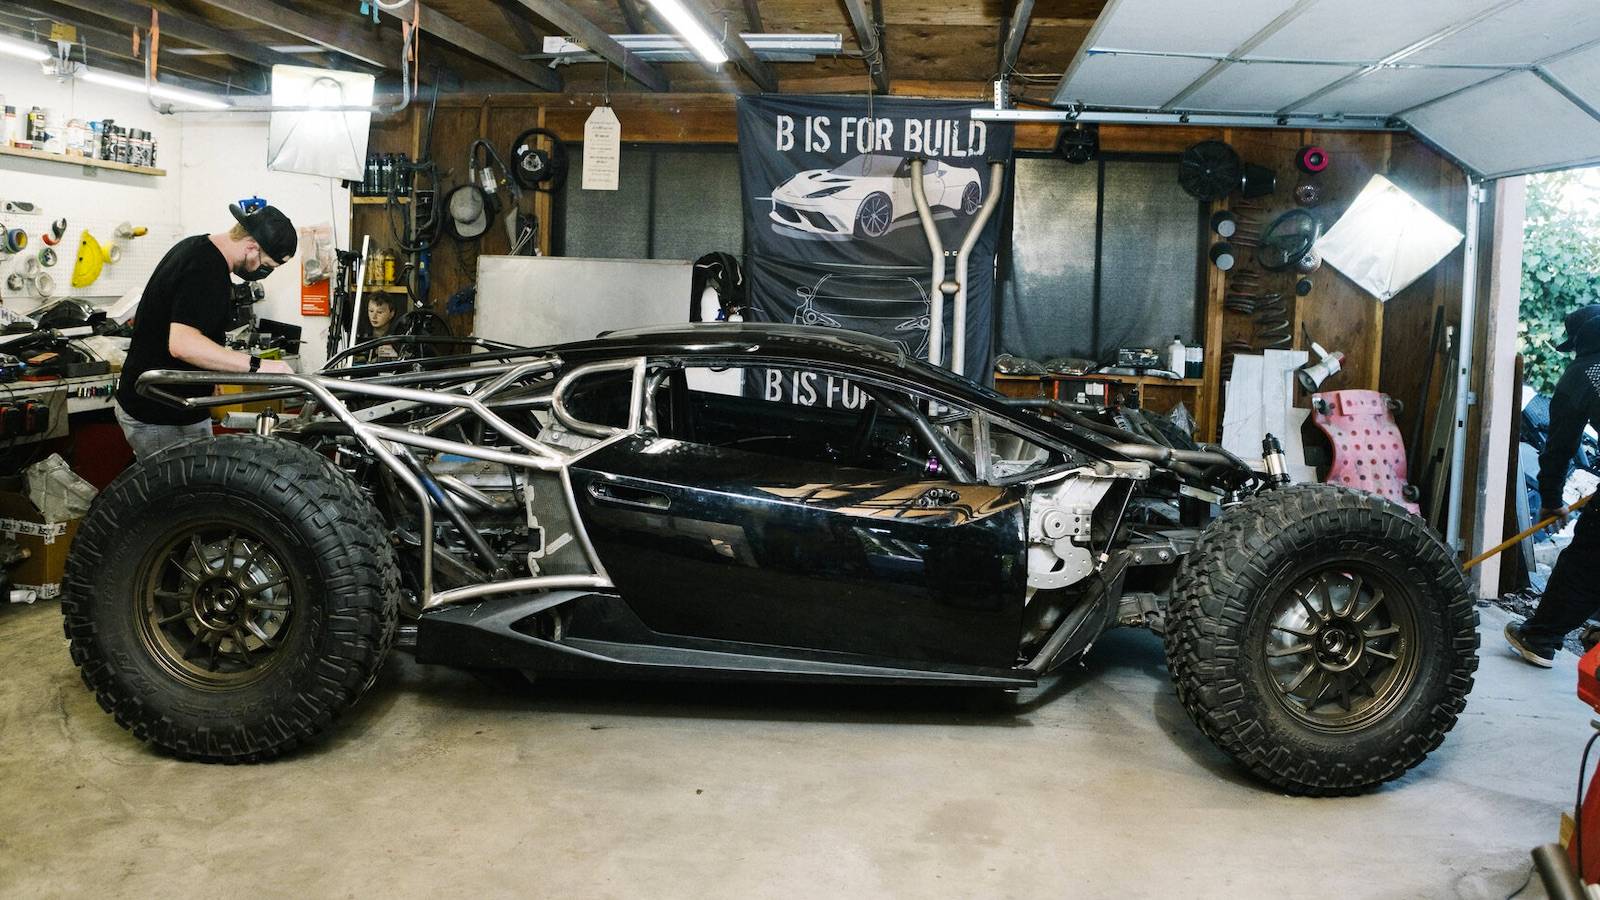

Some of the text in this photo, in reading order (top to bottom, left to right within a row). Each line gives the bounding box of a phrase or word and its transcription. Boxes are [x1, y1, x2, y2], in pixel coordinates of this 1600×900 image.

[776, 115, 987, 157] B IS FOR BUILD
[765, 368, 782, 402] B
[792, 371, 817, 406] IS
